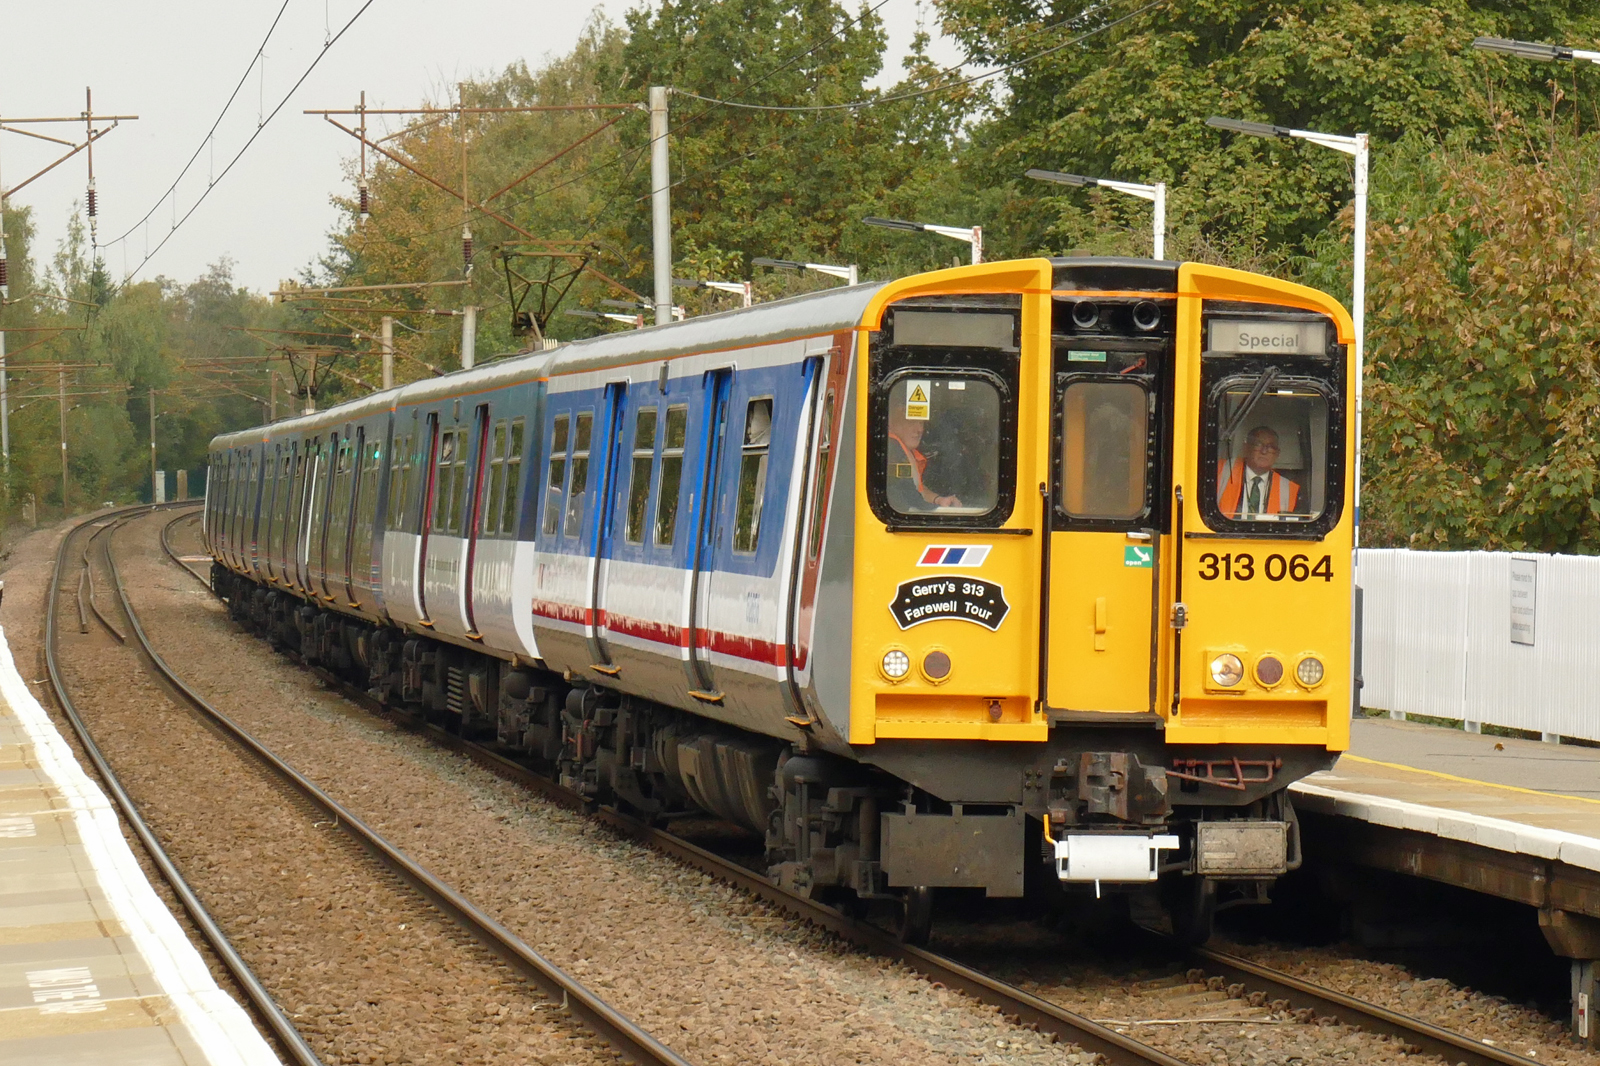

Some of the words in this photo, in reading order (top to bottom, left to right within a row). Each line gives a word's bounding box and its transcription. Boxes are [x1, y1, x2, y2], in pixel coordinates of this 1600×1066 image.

[1239, 333, 1299, 349] Special
[1198, 553, 1255, 581] 313
[1264, 553, 1334, 582] 064
[912, 581, 956, 597] Gerry's
[962, 583, 985, 597] 313
[903, 601, 958, 621] Farewell
[964, 602, 993, 620] Tour
